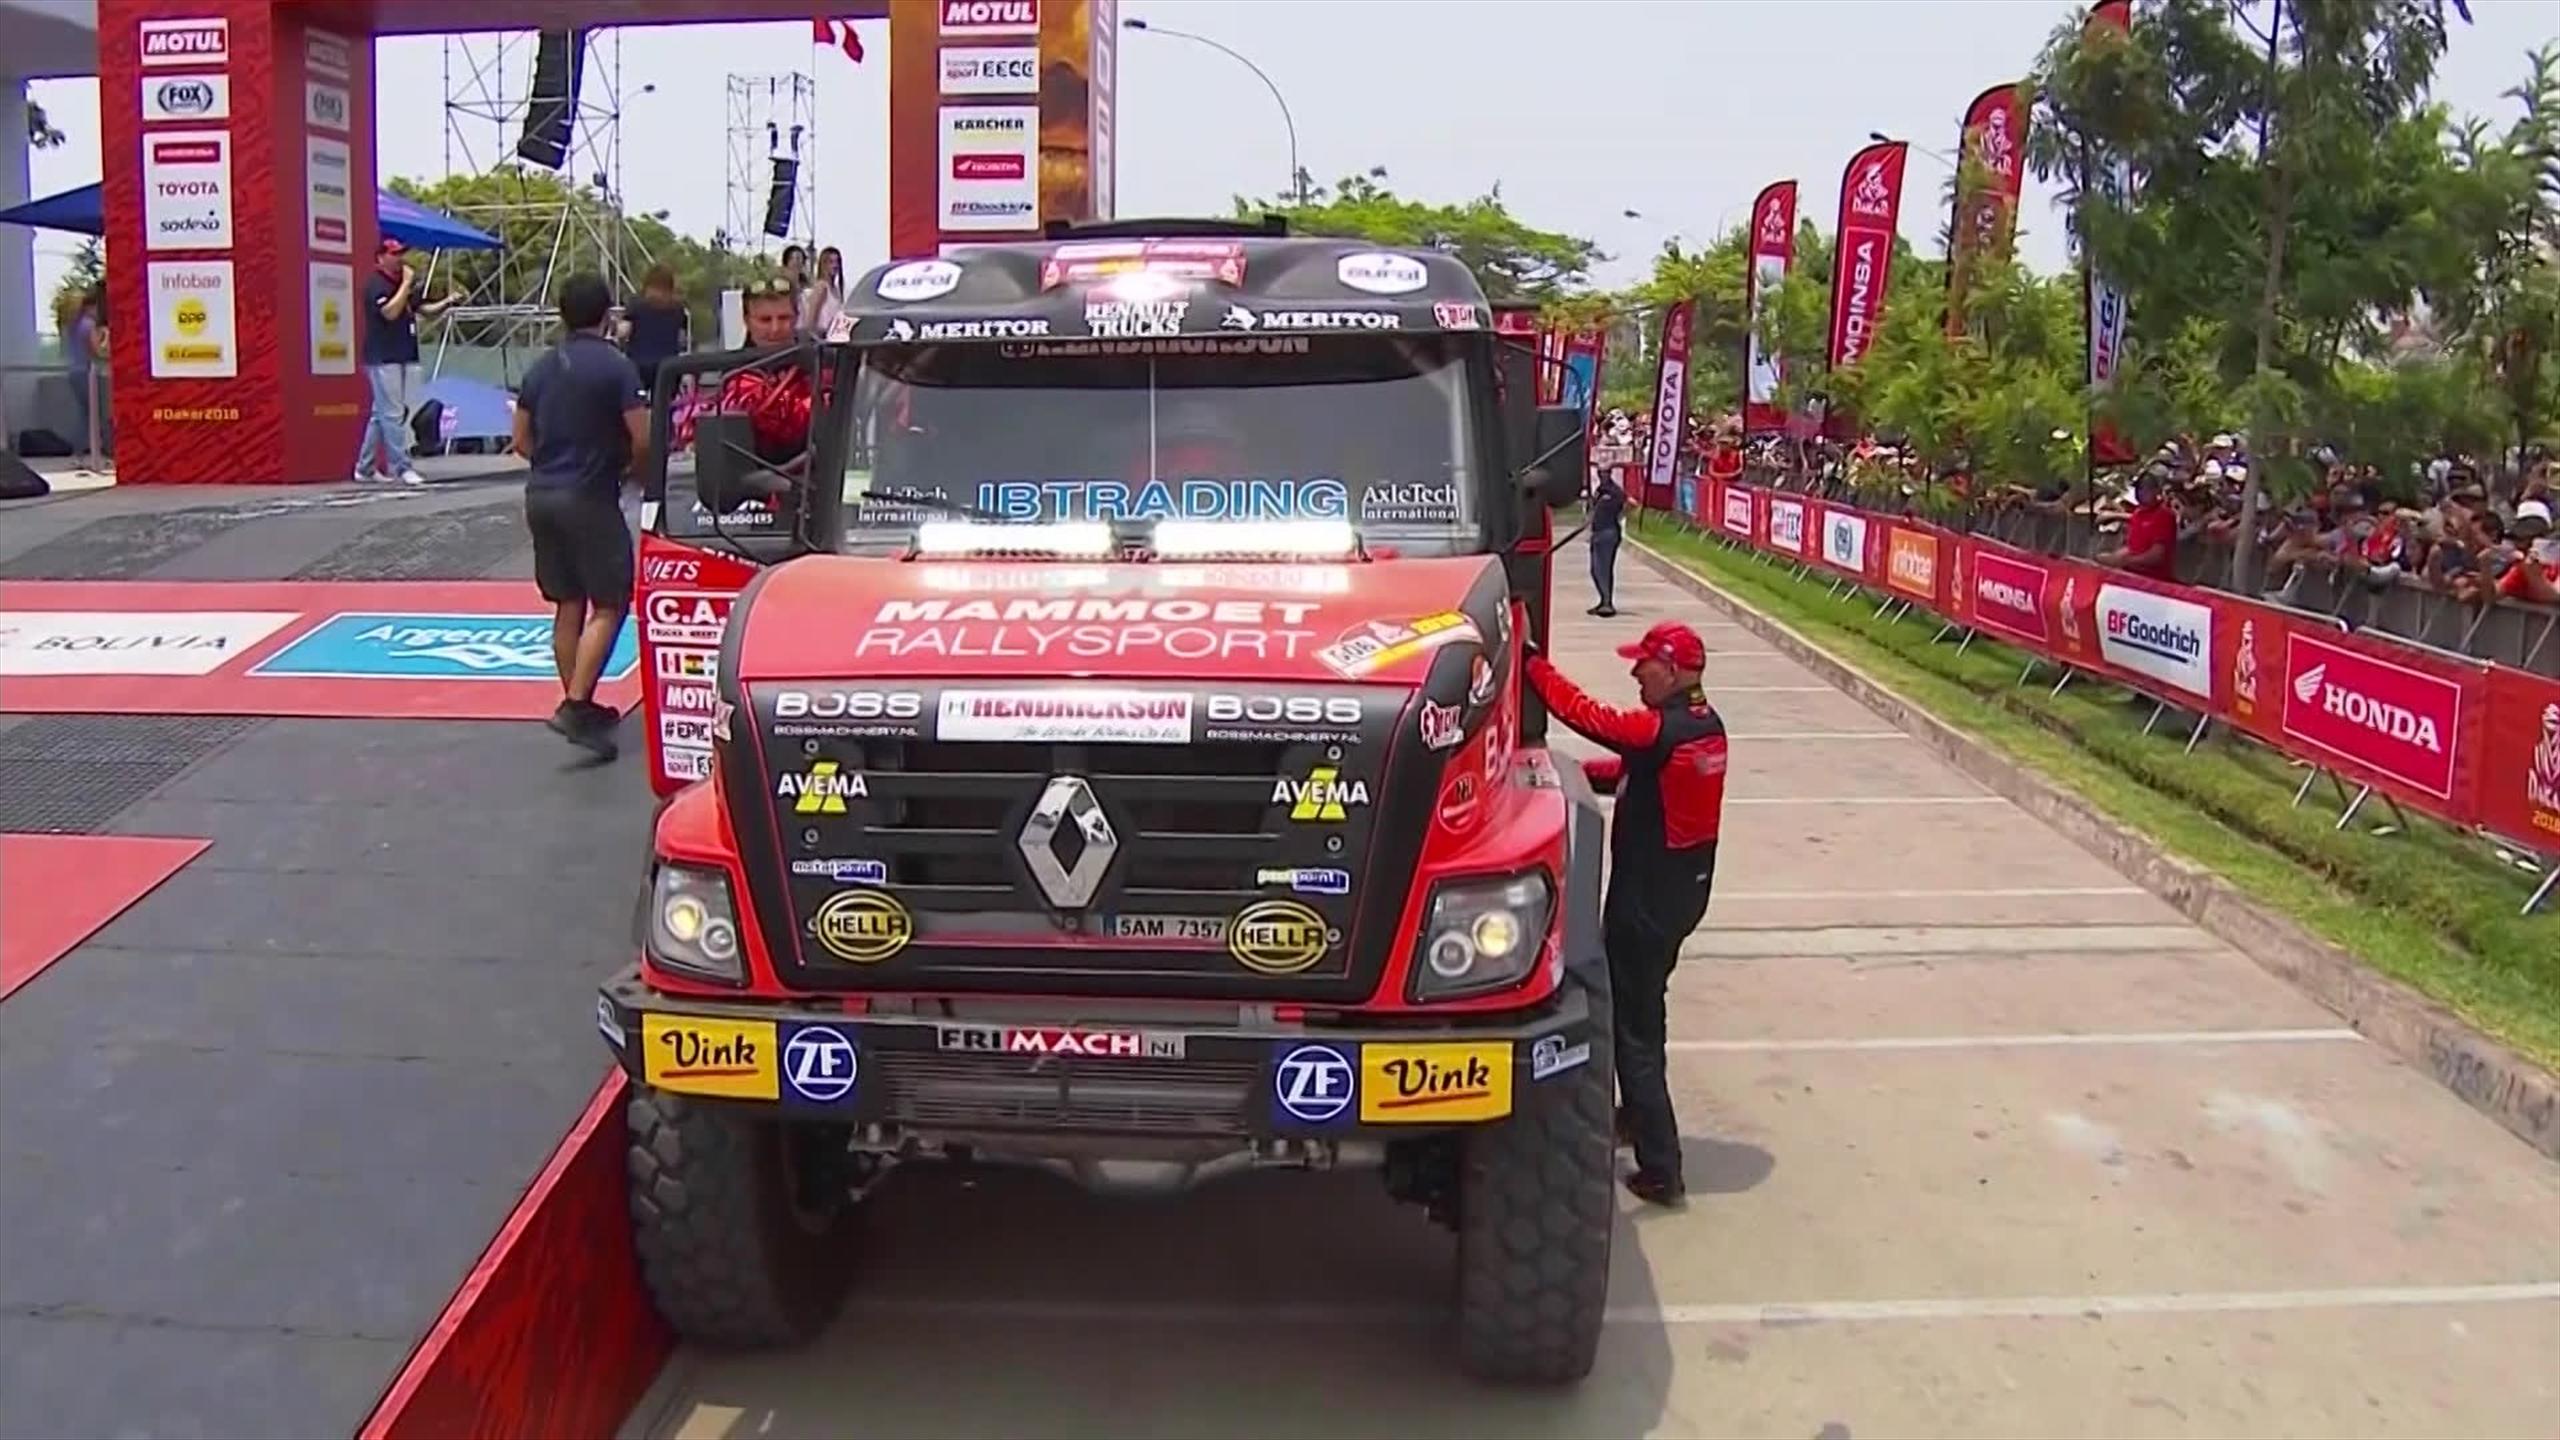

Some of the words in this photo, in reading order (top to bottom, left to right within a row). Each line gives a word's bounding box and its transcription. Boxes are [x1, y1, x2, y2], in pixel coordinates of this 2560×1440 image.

[946, 2, 1034, 22] MOTUL
[147, 31, 223, 52] MOTUL
[169, 86, 202, 105] FOX
[158, 181, 219, 197] TOYOTA
[160, 216, 220, 232] sodexo
[1085, 301, 1190, 320] RENAULT
[1843, 240, 1875, 366] MOINSA
[920, 320, 1050, 340] MERITOR
[1089, 318, 1181, 337] TRUCKS
[1262, 312, 1400, 329] MERITOR
[1655, 371, 1680, 473] TOYOTA
[1362, 483, 1459, 505] AxleTech
[859, 510, 948, 522] International
[1362, 505, 1460, 520] International
[875, 599, 1322, 623] MAMMOET
[854, 626, 1318, 657] RALLYSPORT
[2107, 609, 2200, 658] BFGoodrich
[776, 691, 923, 718] BOSS
[972, 697, 1187, 720] HENDRICKSON
[1206, 696, 1363, 723] BOSS
[2322, 681, 2442, 754] HONDA
[778, 772, 868, 797] AVEMA
[1271, 780, 1370, 804] AVEMA
[828, 916, 907, 937] HELLA
[1120, 918, 1164, 937] 5AM
[1178, 919, 1223, 939] 7357
[1240, 923, 1324, 948] HELLA
[660, 1029, 756, 1068] Vink
[1382, 1056, 1490, 1097] Vink
